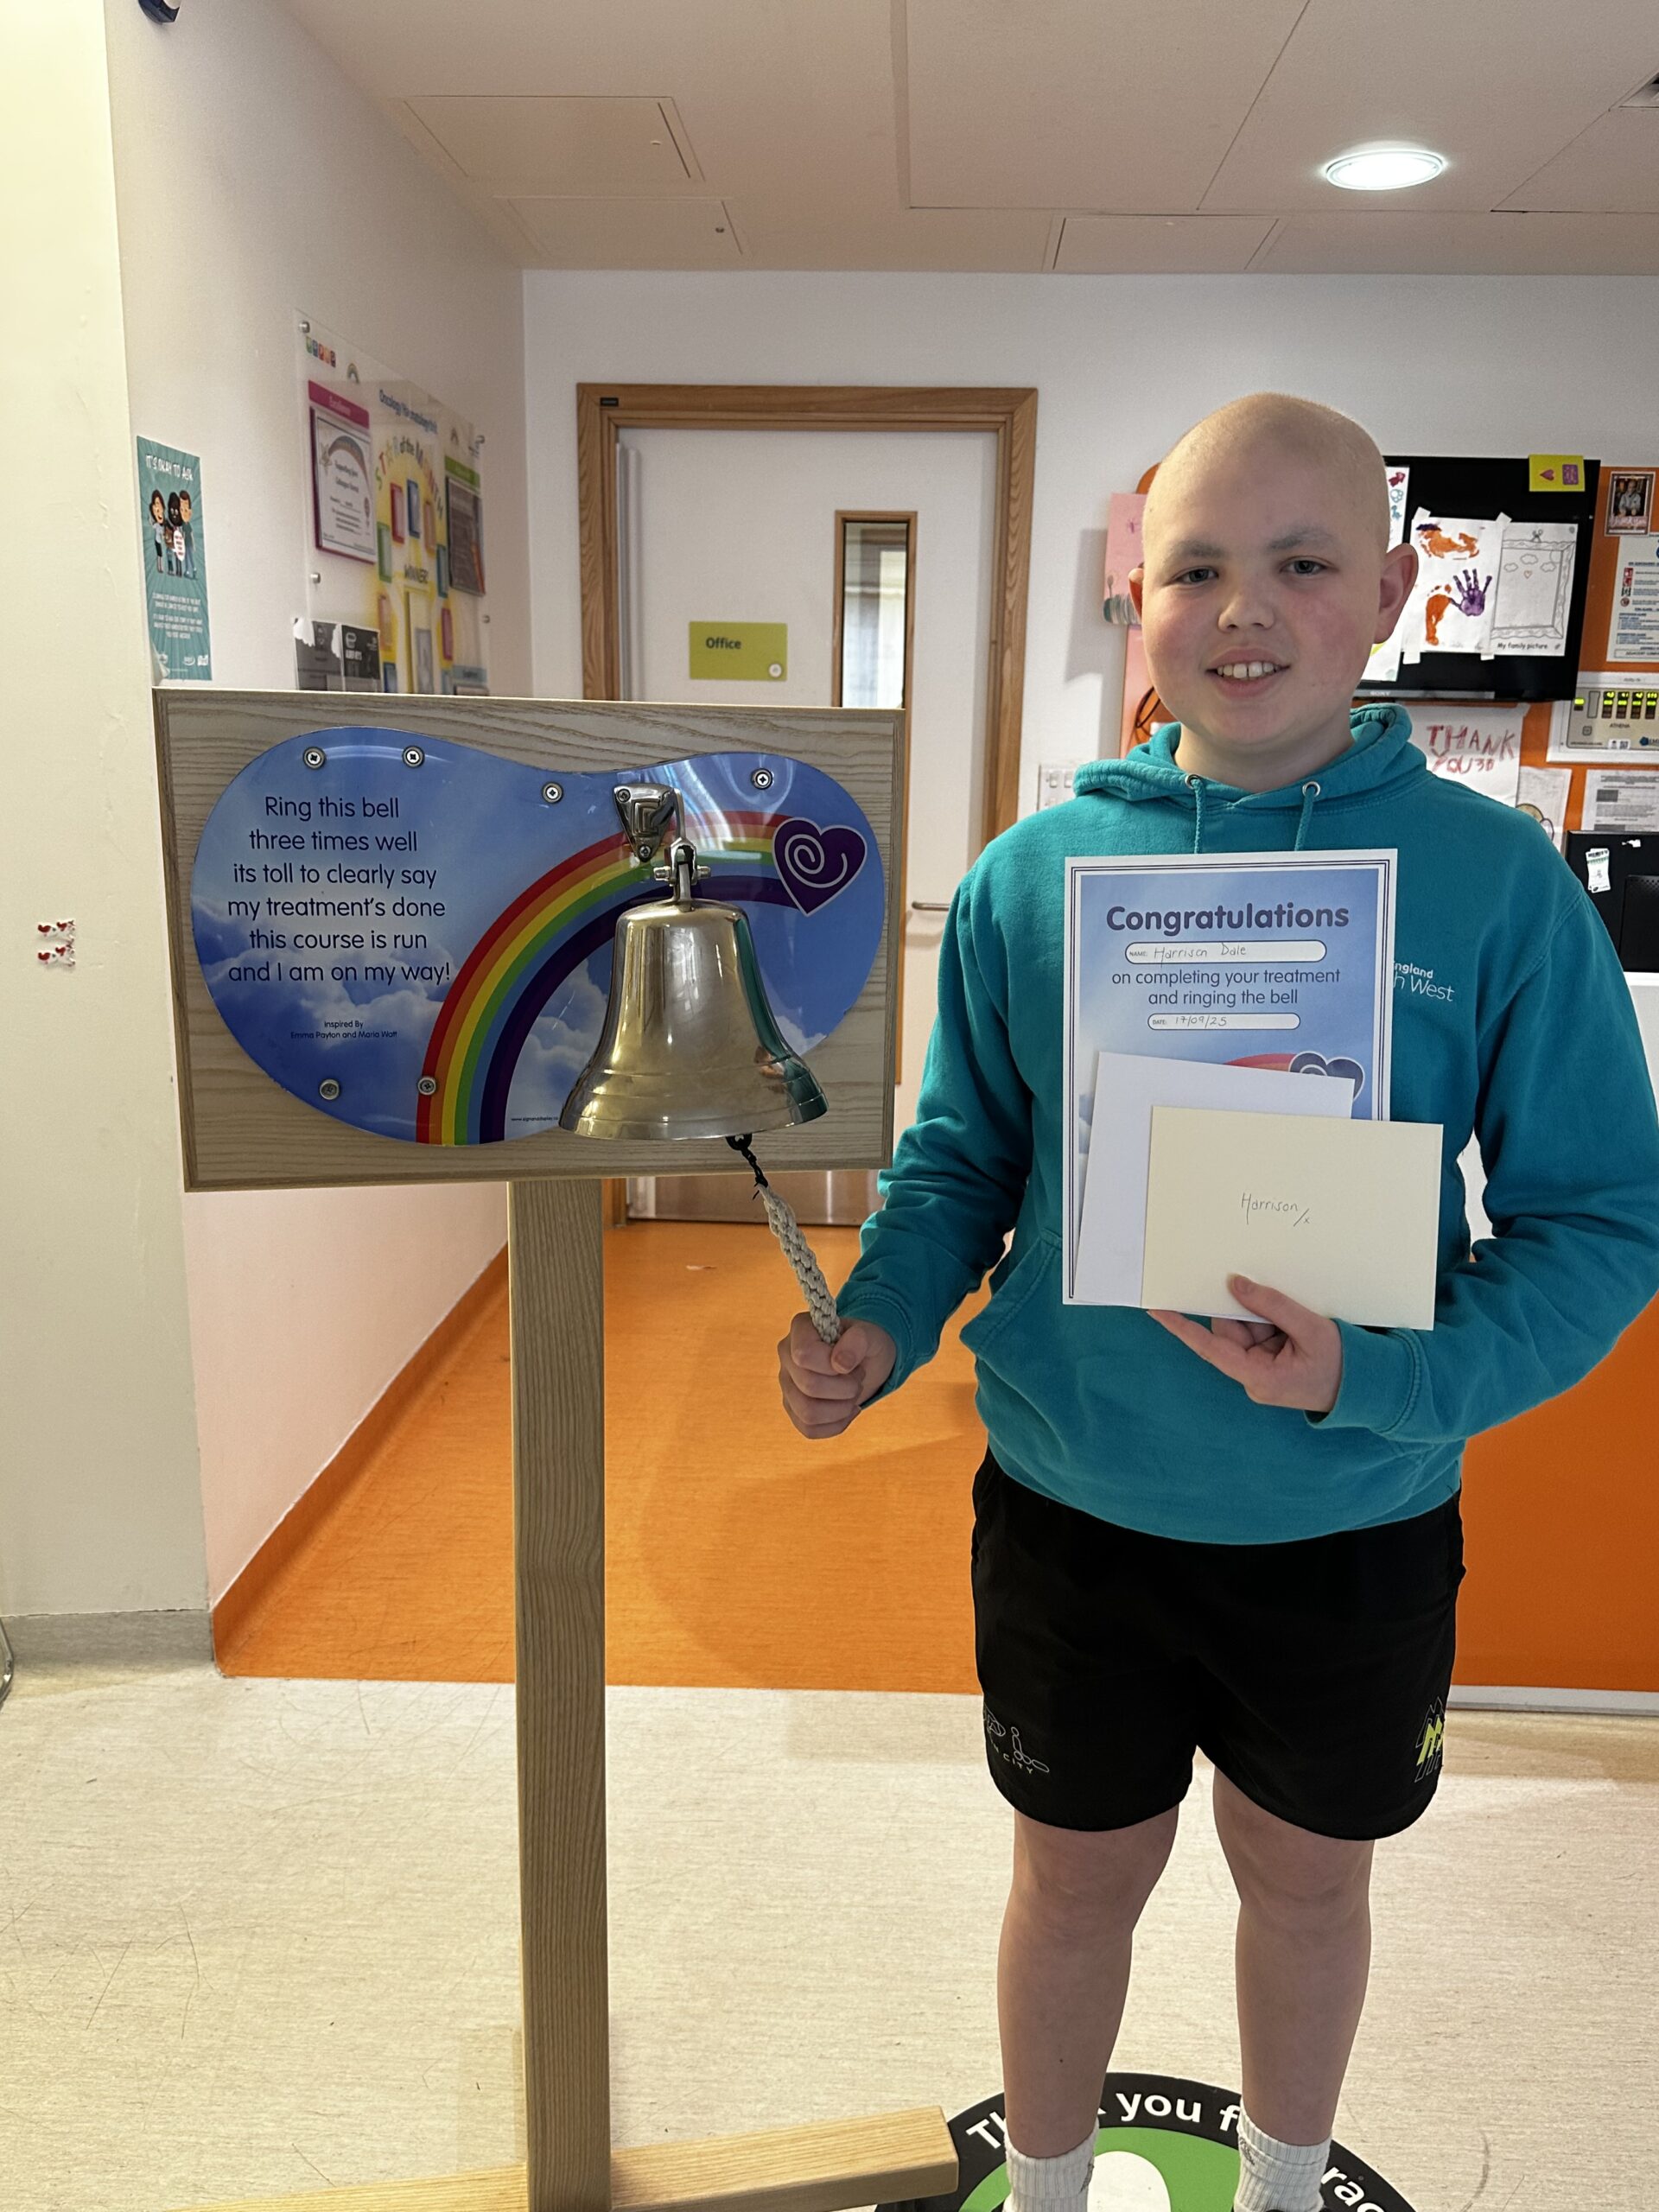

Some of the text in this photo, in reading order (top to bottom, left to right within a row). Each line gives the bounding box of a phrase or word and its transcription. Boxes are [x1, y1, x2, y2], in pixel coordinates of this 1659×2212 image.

[173, 464, 181, 477] TO
[705, 638, 741, 650] Office
[1427, 725, 1515, 761] THANK
[1431, 748, 1472, 774] YOU
[265, 797, 398, 821] Ring this bell
[249, 830, 416, 851] three times well
[234, 863, 436, 888] its toll to clearly say
[228, 898, 445, 920] my treatment's done
[1106, 904, 1349, 936] Congratulations
[250, 930, 427, 949] this course is run
[1154, 947, 1208, 968] Harrison
[1221, 943, 1246, 956] Dale
[229, 962, 450, 985] and I am on my way!
[1112, 969, 1340, 987] on completing your treatment
[1393, 961, 1433, 979] ngland
[1148, 989, 1298, 1007] and ringing the bell
[1411, 975, 1454, 1001] West
[325, 1020, 364, 1029] Inspired By
[1175, 1015, 1227, 1028] 17/09/25
[316, 1032, 340, 1040] Payton
[1003, 1752, 1033, 1774] CITY
[1116, 2093, 1201, 2123] you
